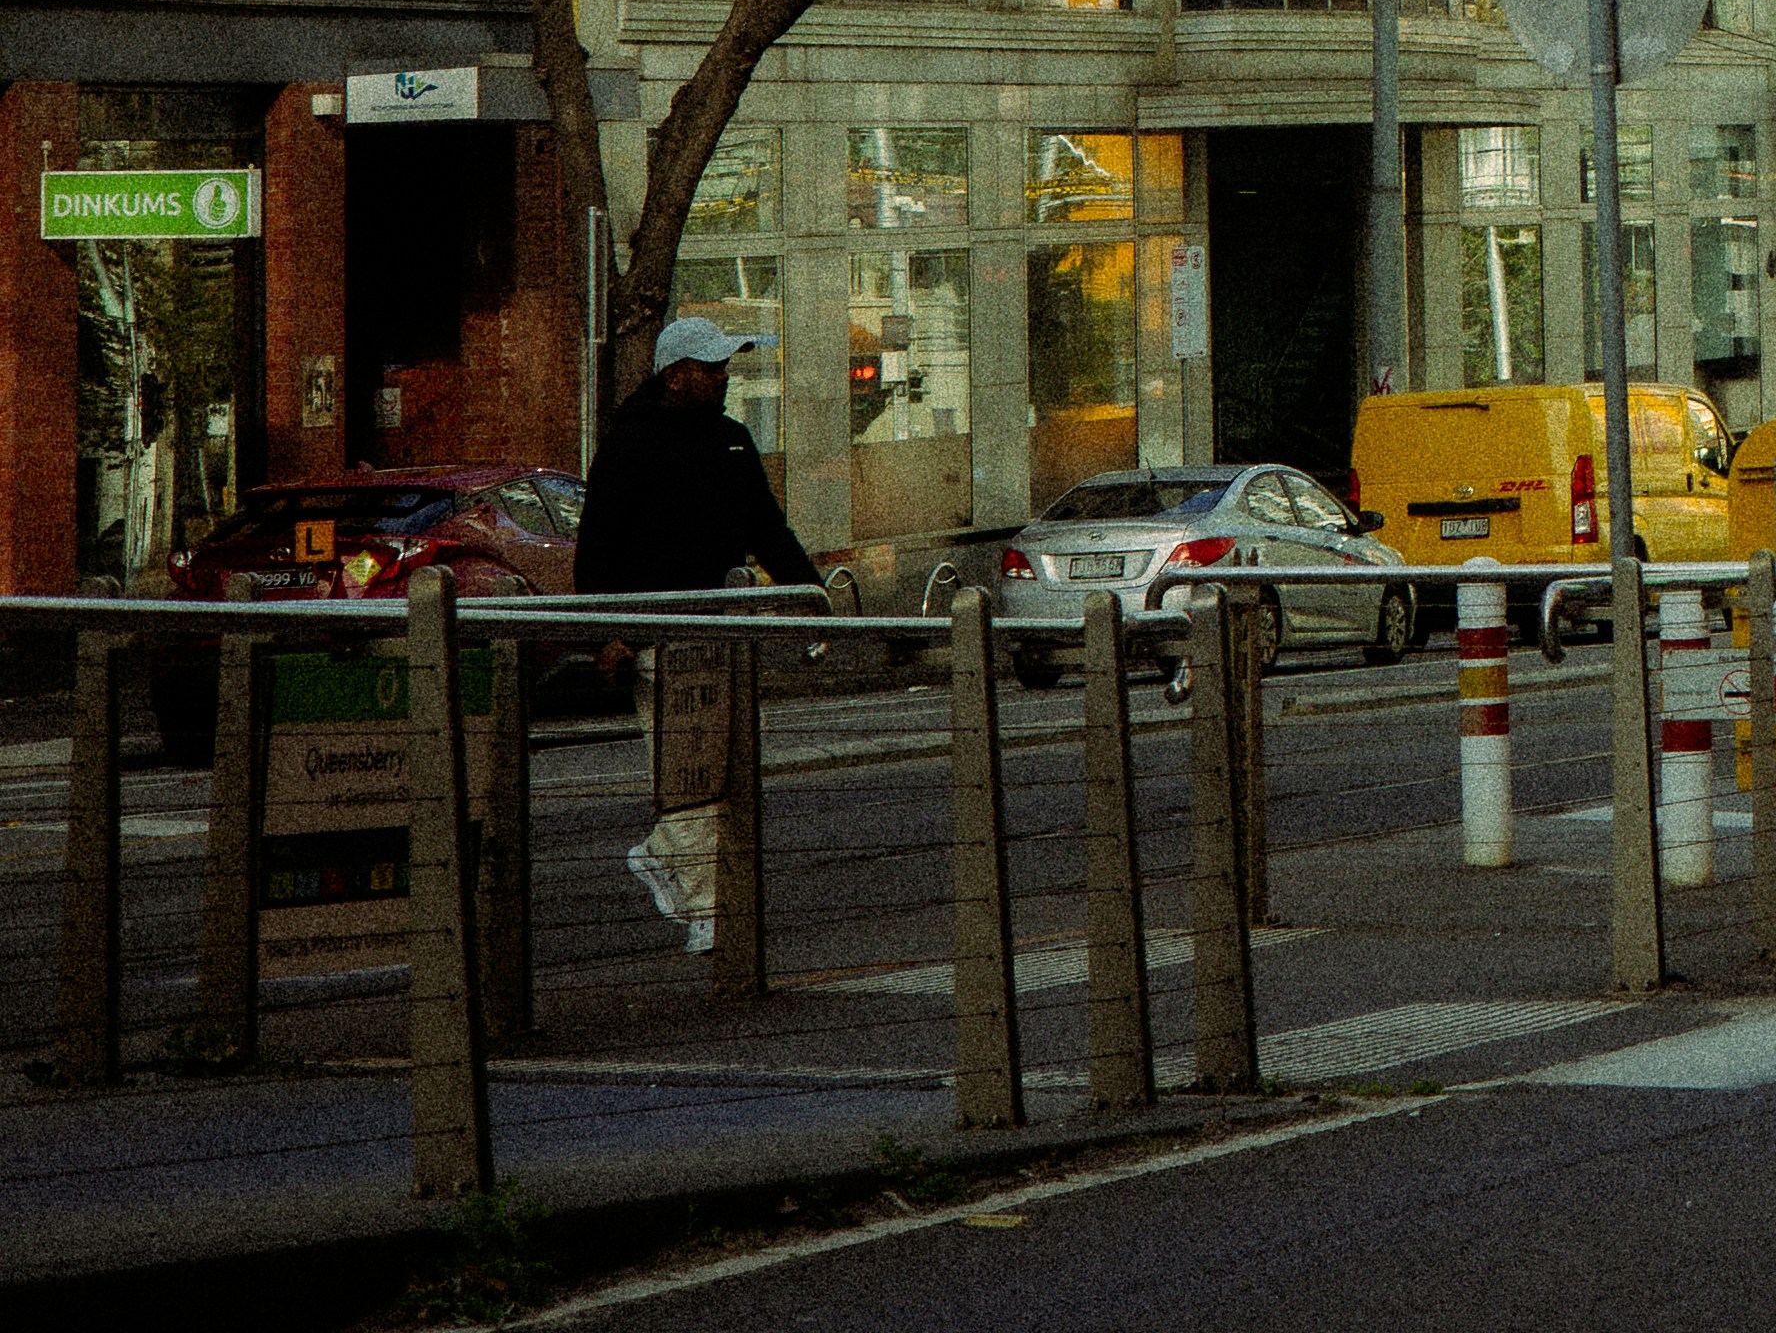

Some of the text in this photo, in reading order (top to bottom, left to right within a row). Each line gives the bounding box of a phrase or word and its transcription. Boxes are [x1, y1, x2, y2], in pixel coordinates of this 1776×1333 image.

[53, 191, 182, 218] DINKUMS
[1499, 480, 1546, 493] DHL
[305, 527, 326, 555] L
[304, 746, 405, 782] Queensberry
